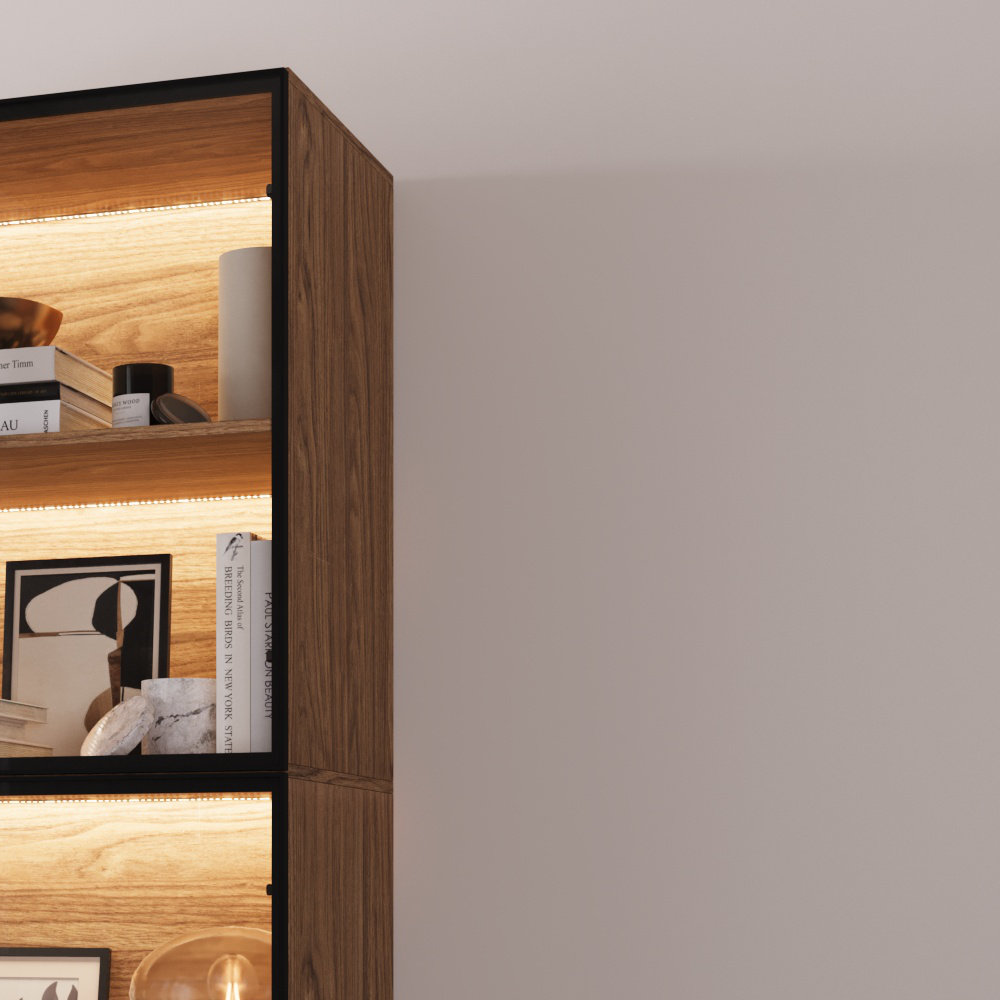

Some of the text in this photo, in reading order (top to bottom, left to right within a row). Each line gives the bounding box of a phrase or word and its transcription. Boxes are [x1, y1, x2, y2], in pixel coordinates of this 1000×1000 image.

[12, 359, 34, 369] Timm
[236, 565, 244, 578] The
[236, 579, 244, 603] Second
[236, 604, 244, 621] Atlas
[224, 566, 232, 754] BREEDING BIRDS IN NEW YORK STATE
